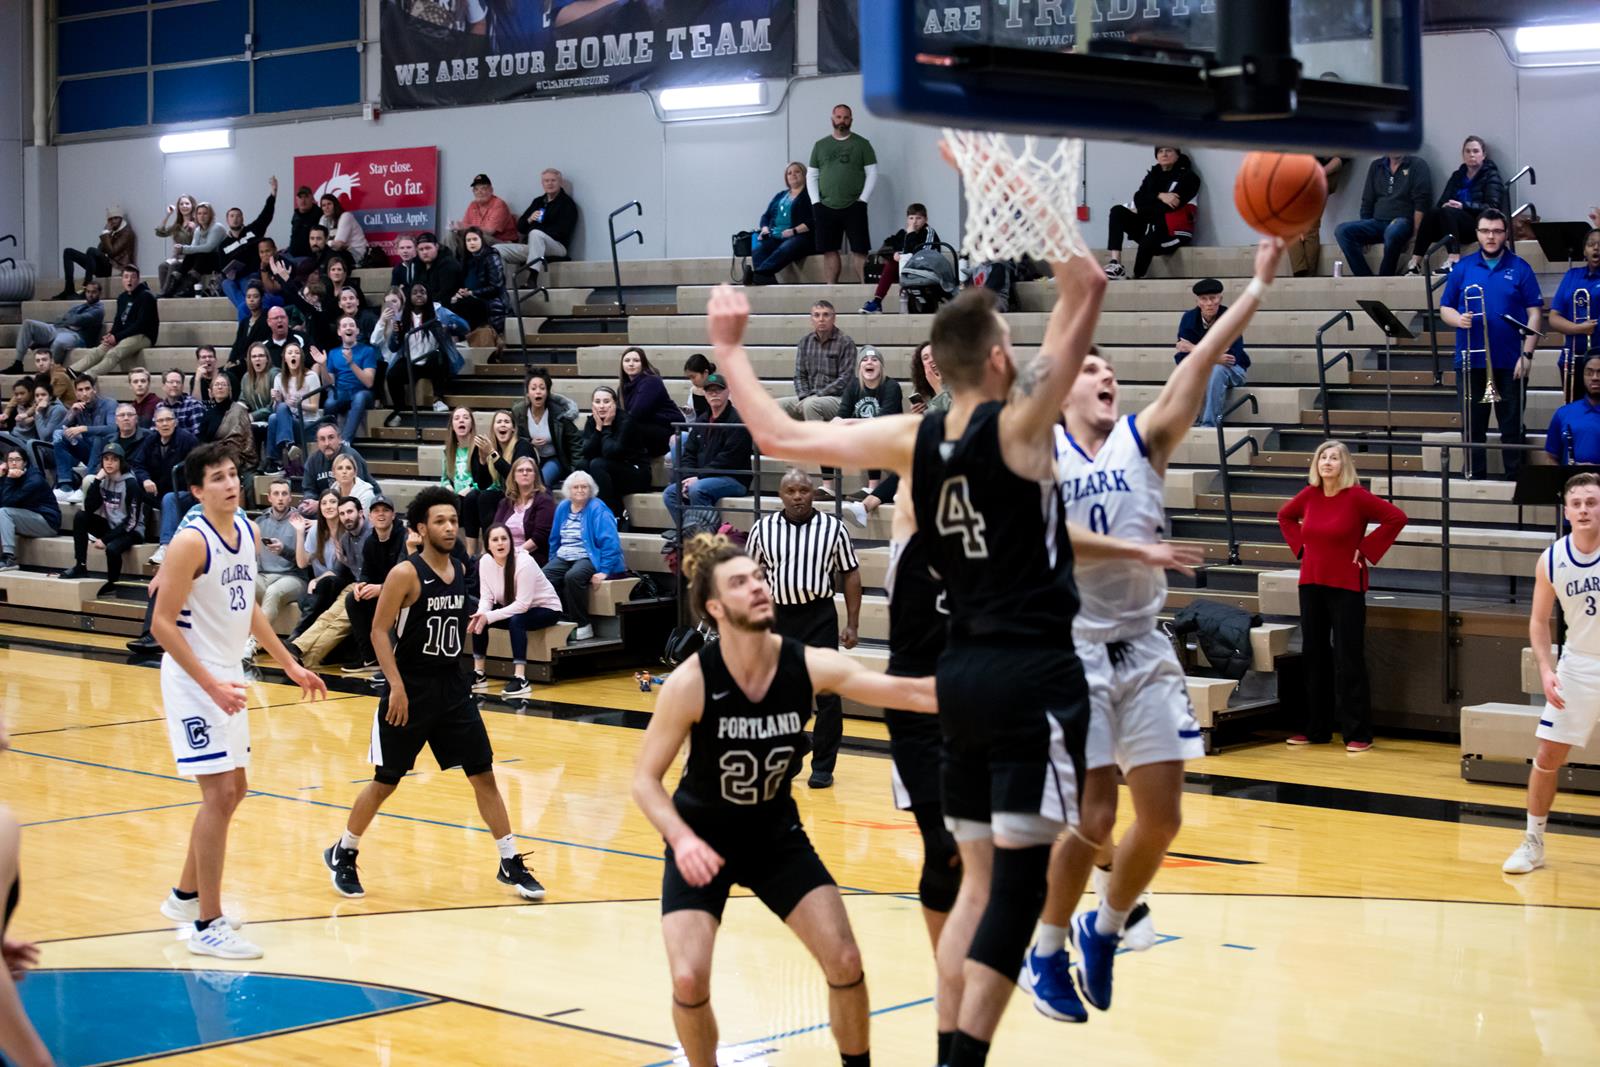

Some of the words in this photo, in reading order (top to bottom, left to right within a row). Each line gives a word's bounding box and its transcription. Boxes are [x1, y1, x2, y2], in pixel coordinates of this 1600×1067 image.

[923, 5, 981, 34] ARE
[395, 62, 430, 86] WE
[436, 57, 479, 82] ARE
[485, 50, 545, 77] YOUR
[555, 30, 654, 71] HOME
[666, 18, 772, 60] TEAM
[536, 74, 610, 90] #CLARKPENGUINS
[369, 162, 388, 177] Stay
[390, 161, 413, 174] close.
[384, 179, 402, 196] Go
[405, 178, 424, 195] far.
[364, 213, 383, 226] Call.
[385, 212, 404, 225] Visit.
[405, 213, 429, 226] Apply.
[1060, 469, 1131, 502] CLARK
[936, 474, 989, 559] 4
[1089, 504, 1110, 535] 0
[230, 585, 246, 611] 23
[1585, 595, 1597, 616] 3
[422, 616, 462, 657] 10
[717, 711, 801, 739] PORTLAND
[719, 746, 795, 805] 22
